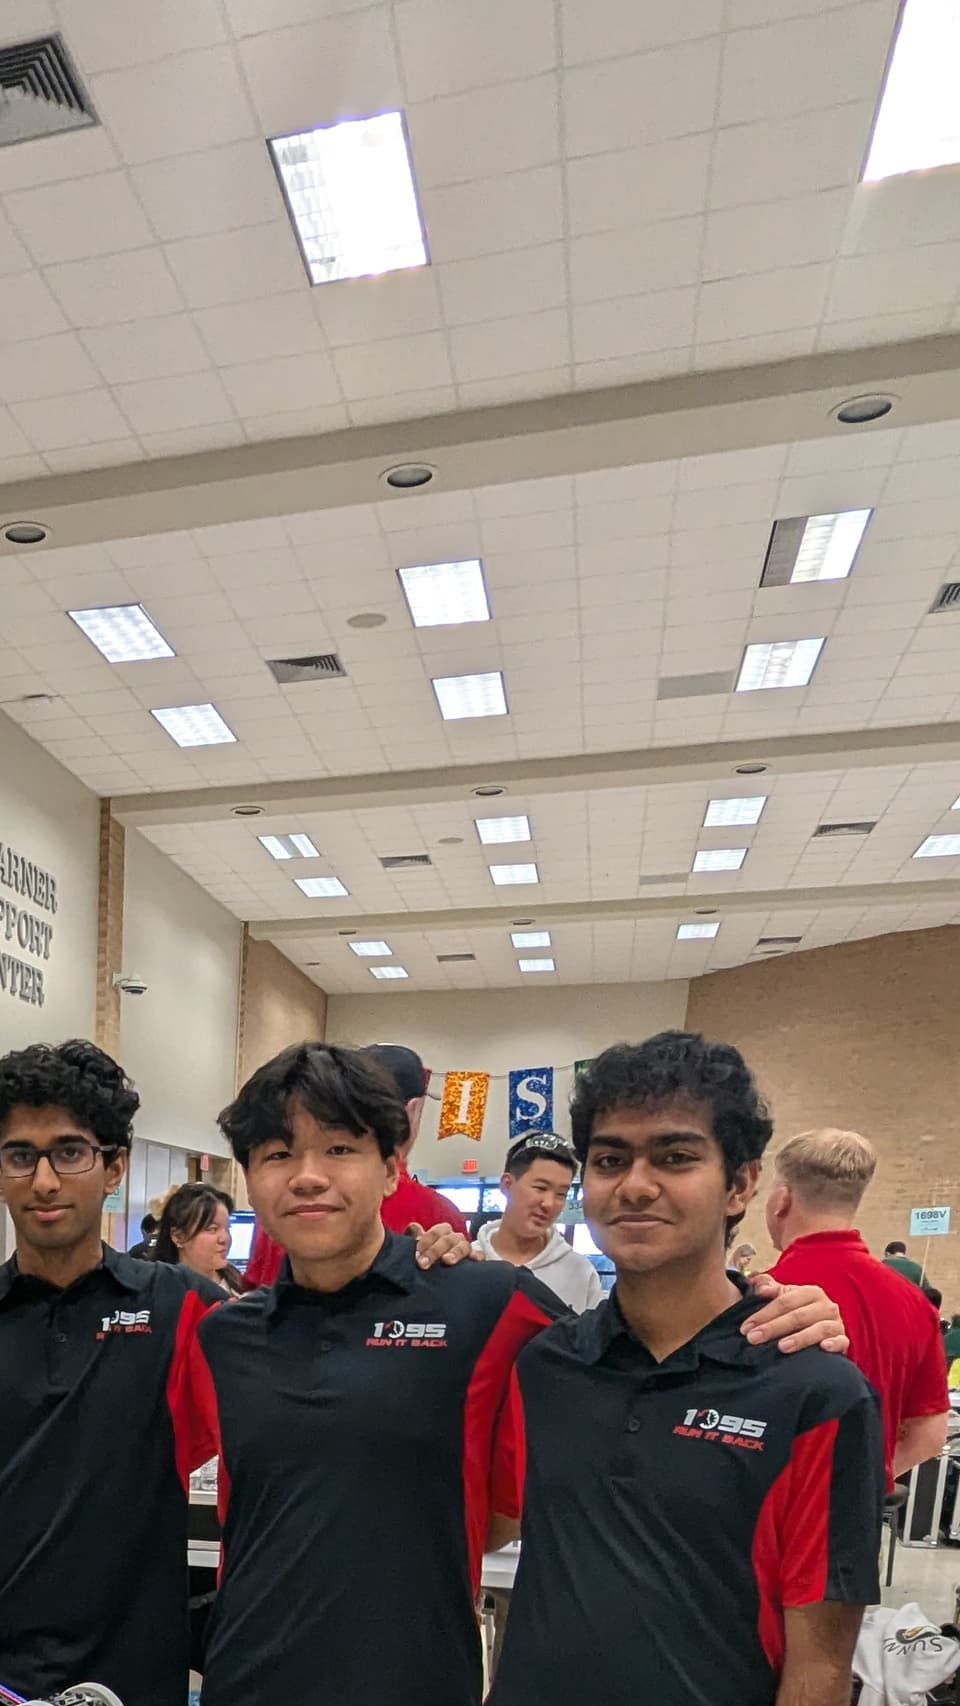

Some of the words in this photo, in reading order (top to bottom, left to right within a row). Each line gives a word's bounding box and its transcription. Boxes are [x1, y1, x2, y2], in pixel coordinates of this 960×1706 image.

[373, 1320, 447, 1339] 1095
[365, 1338, 393, 1347] RUN
[394, 1339, 407, 1347] IT
[410, 1339, 448, 1348] BACK
[682, 1408, 768, 1438] 1095
[672, 1425, 703, 1439] RUN
[704, 1430, 721, 1441] IT
[721, 1433, 764, 1452] BACK
